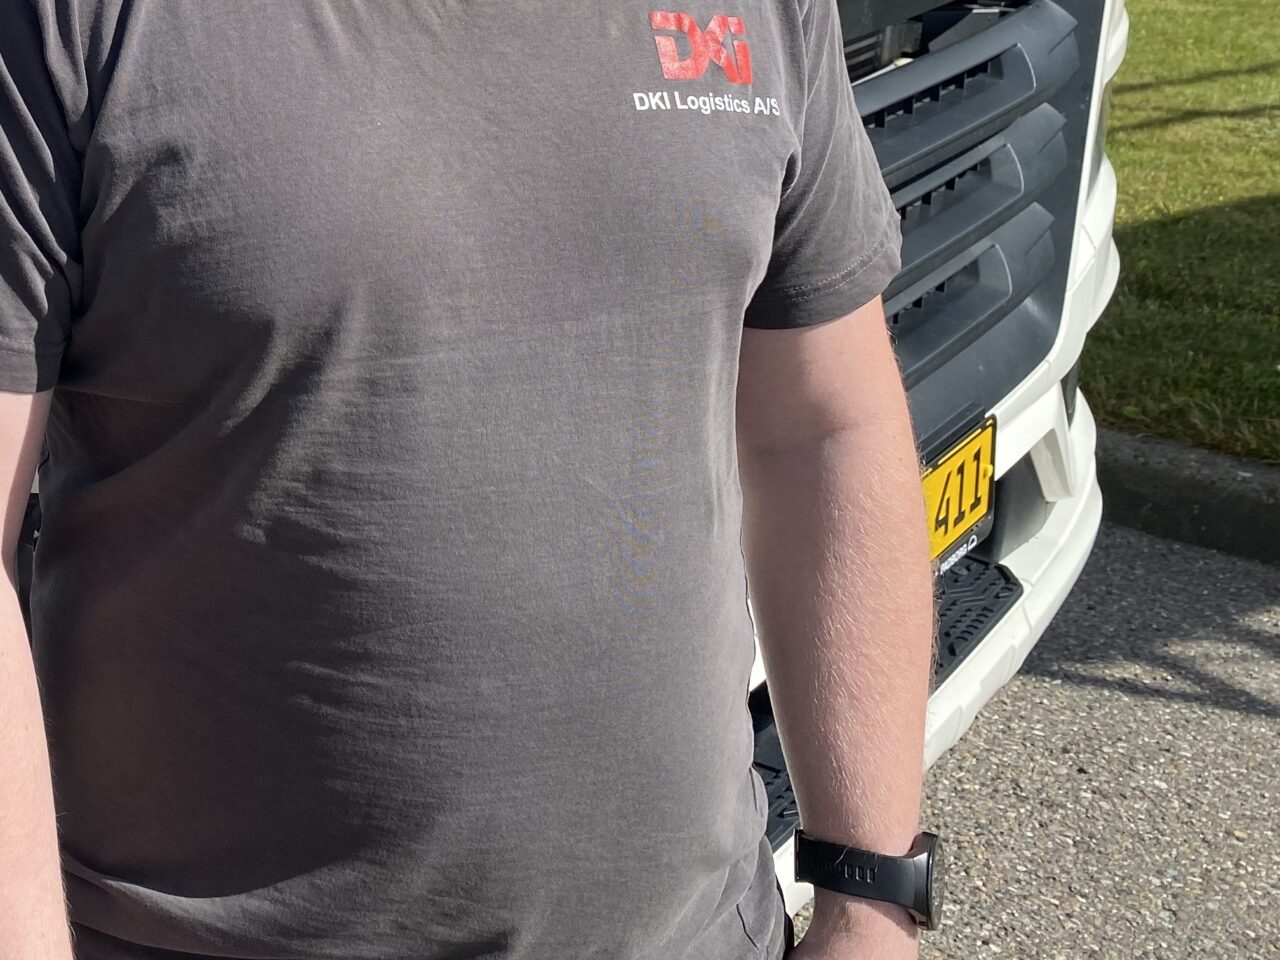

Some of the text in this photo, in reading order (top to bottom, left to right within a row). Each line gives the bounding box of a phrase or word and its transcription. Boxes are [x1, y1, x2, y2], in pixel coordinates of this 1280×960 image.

[632, 91, 781, 116] DKI Logistics A/S
[935, 447, 981, 535] 411
